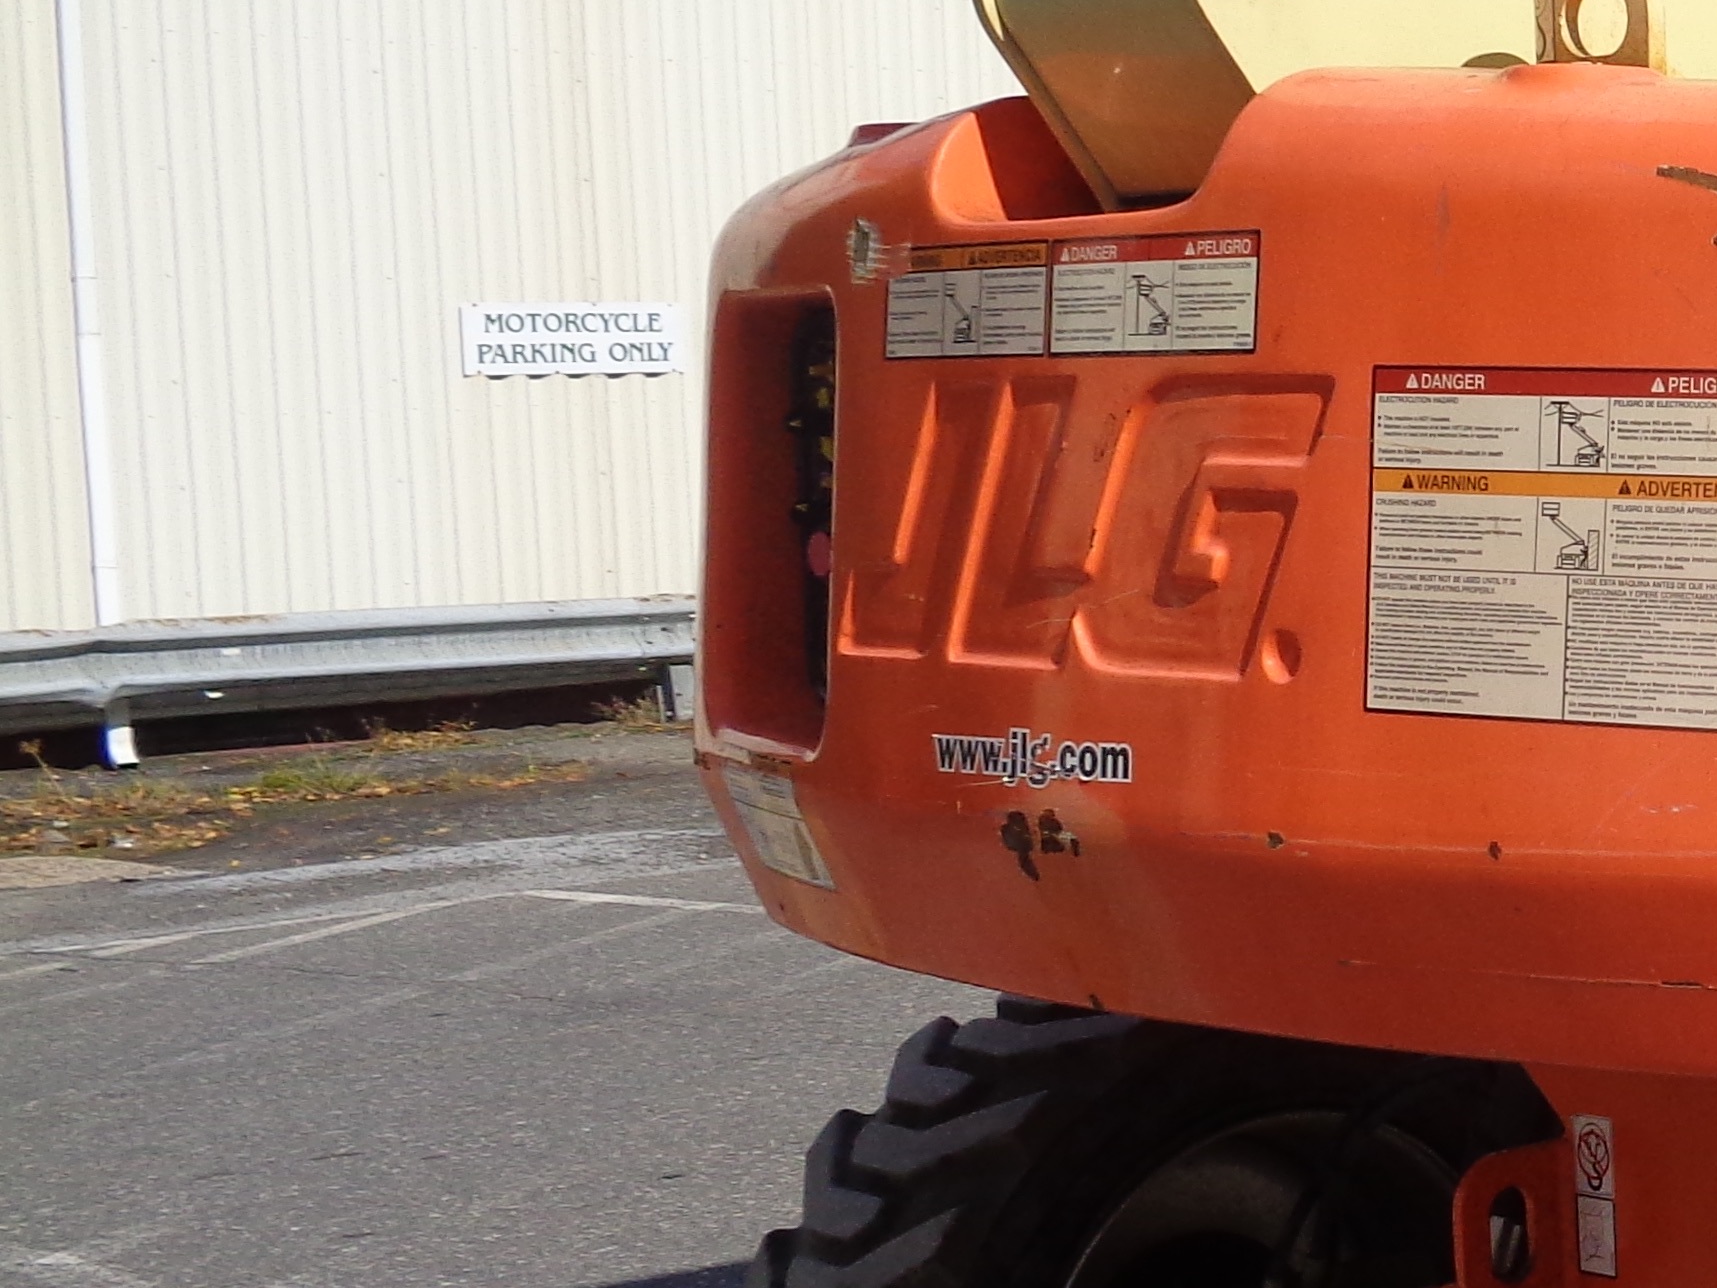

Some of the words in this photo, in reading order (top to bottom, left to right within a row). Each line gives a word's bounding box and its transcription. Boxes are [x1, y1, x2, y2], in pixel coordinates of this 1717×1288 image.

[1071, 245, 1118, 261] DANGER
[1197, 239, 1251, 256] PELIGRO
[483, 312, 664, 333] MOTORCYCLE
[476, 343, 598, 364] PARKING
[608, 342, 674, 363] ONLY
[1421, 373, 1486, 390] DANGER
[1416, 474, 1490, 492] WARNING
